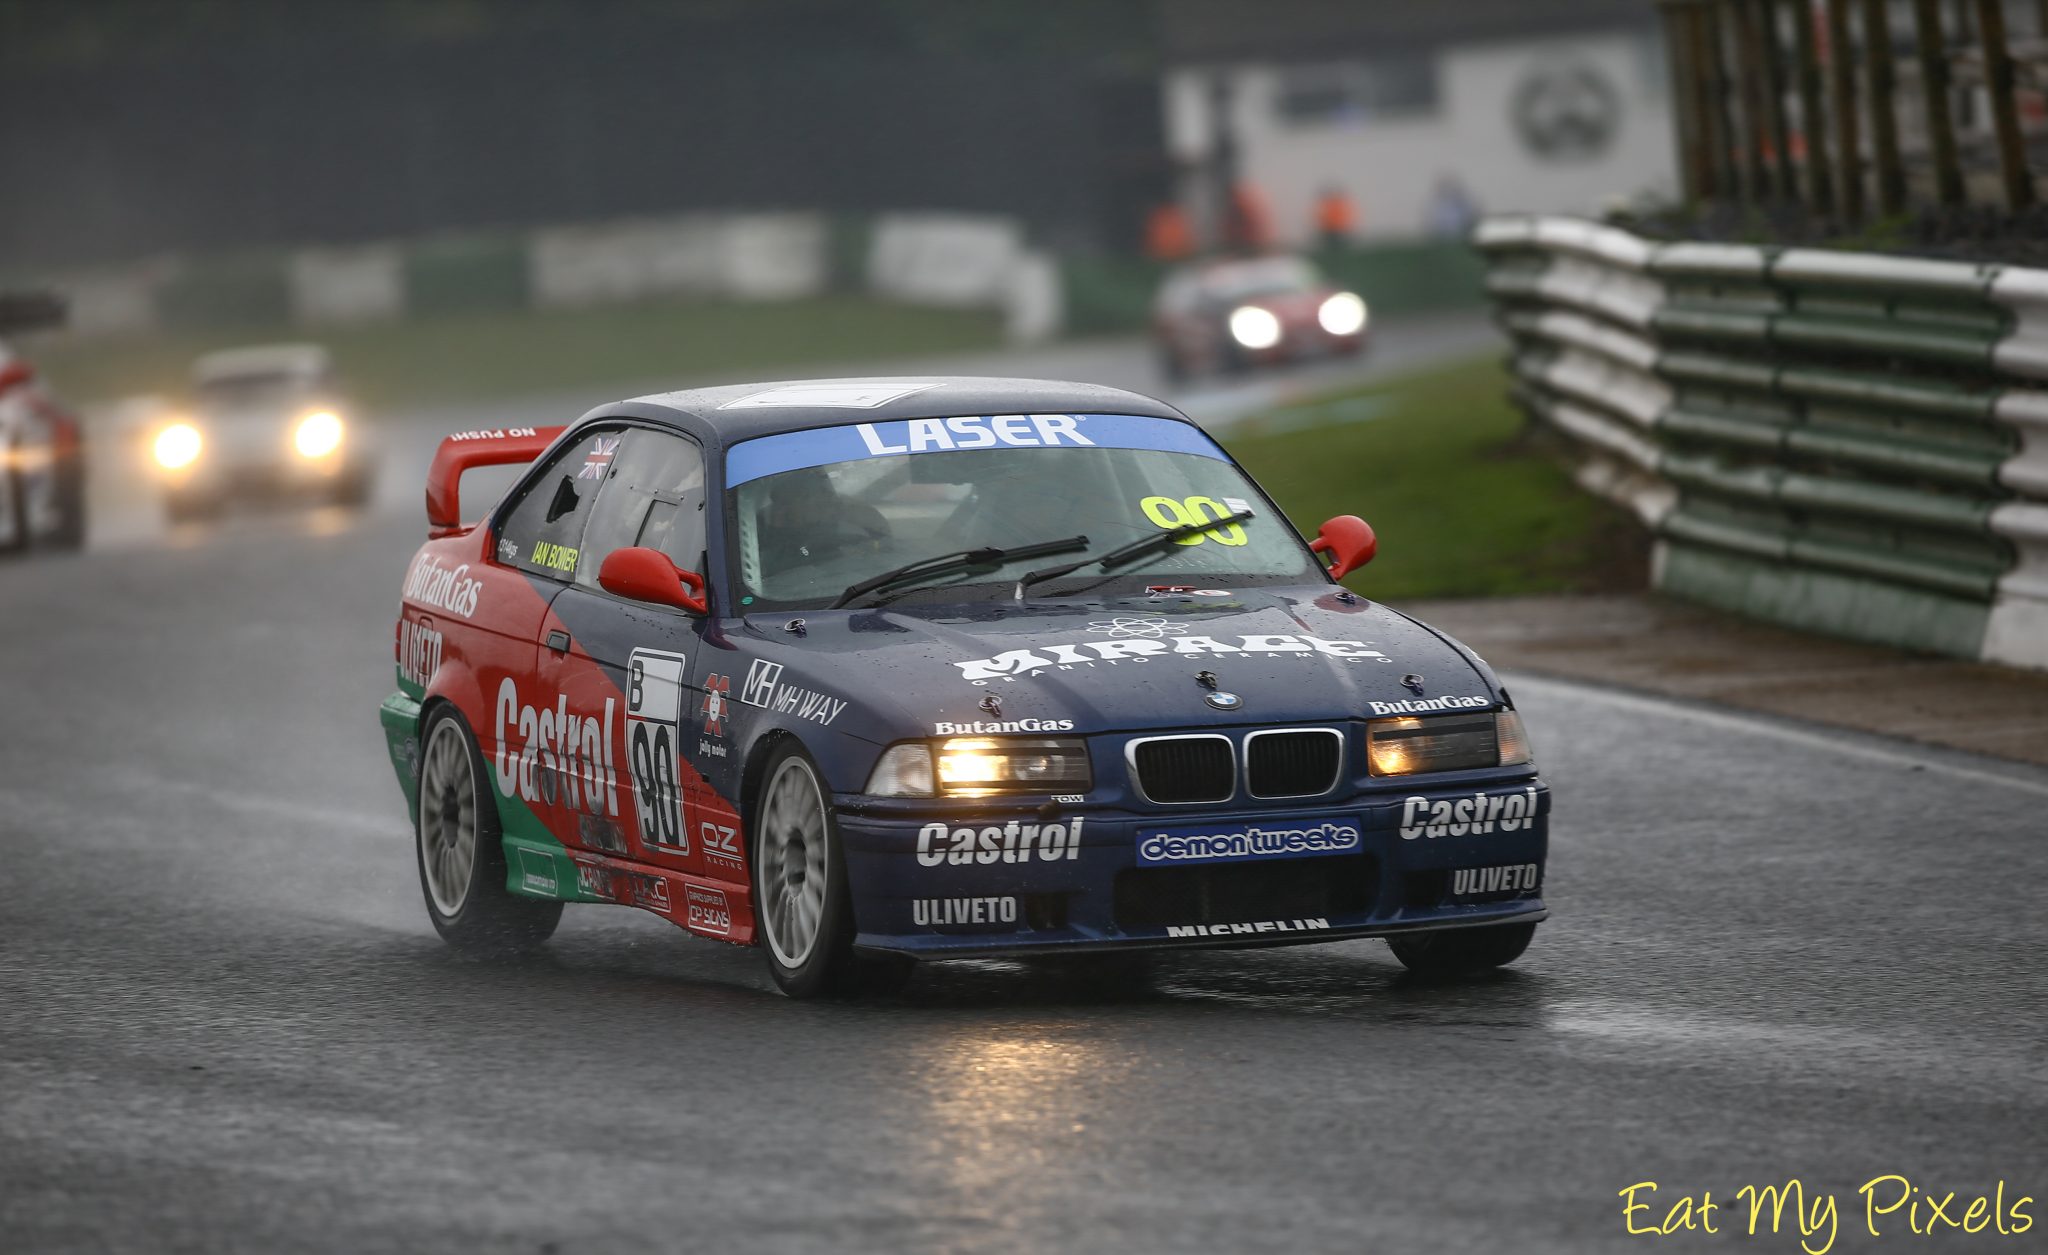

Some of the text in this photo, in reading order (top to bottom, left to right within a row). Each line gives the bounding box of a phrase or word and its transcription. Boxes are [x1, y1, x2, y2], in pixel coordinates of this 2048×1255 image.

[450, 427, 537, 442] NO PUSH!
[856, 415, 1096, 455] LASER
[1140, 496, 1249, 547] 90
[531, 540, 578, 573] IAN BOWER
[406, 553, 483, 618] ButanGas
[953, 634, 1386, 680] MIRAGE
[971, 651, 1393, 686] GRANITO CERAMICO
[628, 659, 645, 712] B
[771, 683, 848, 726] MH WAY
[1368, 694, 1490, 715] ButanGas
[935, 718, 1074, 736] ButanGas
[495, 676, 619, 816] Castrol
[632, 722, 680, 847] 90
[1050, 794, 1084, 803] TOW
[1400, 786, 1538, 840] Castrol
[916, 816, 1085, 867] Castrol
[707, 856, 742, 871] RACING
[1453, 863, 1538, 895] ULIVETO
[913, 896, 1017, 926] ULIVETO
[1166, 917, 1331, 938] MICHELIN
